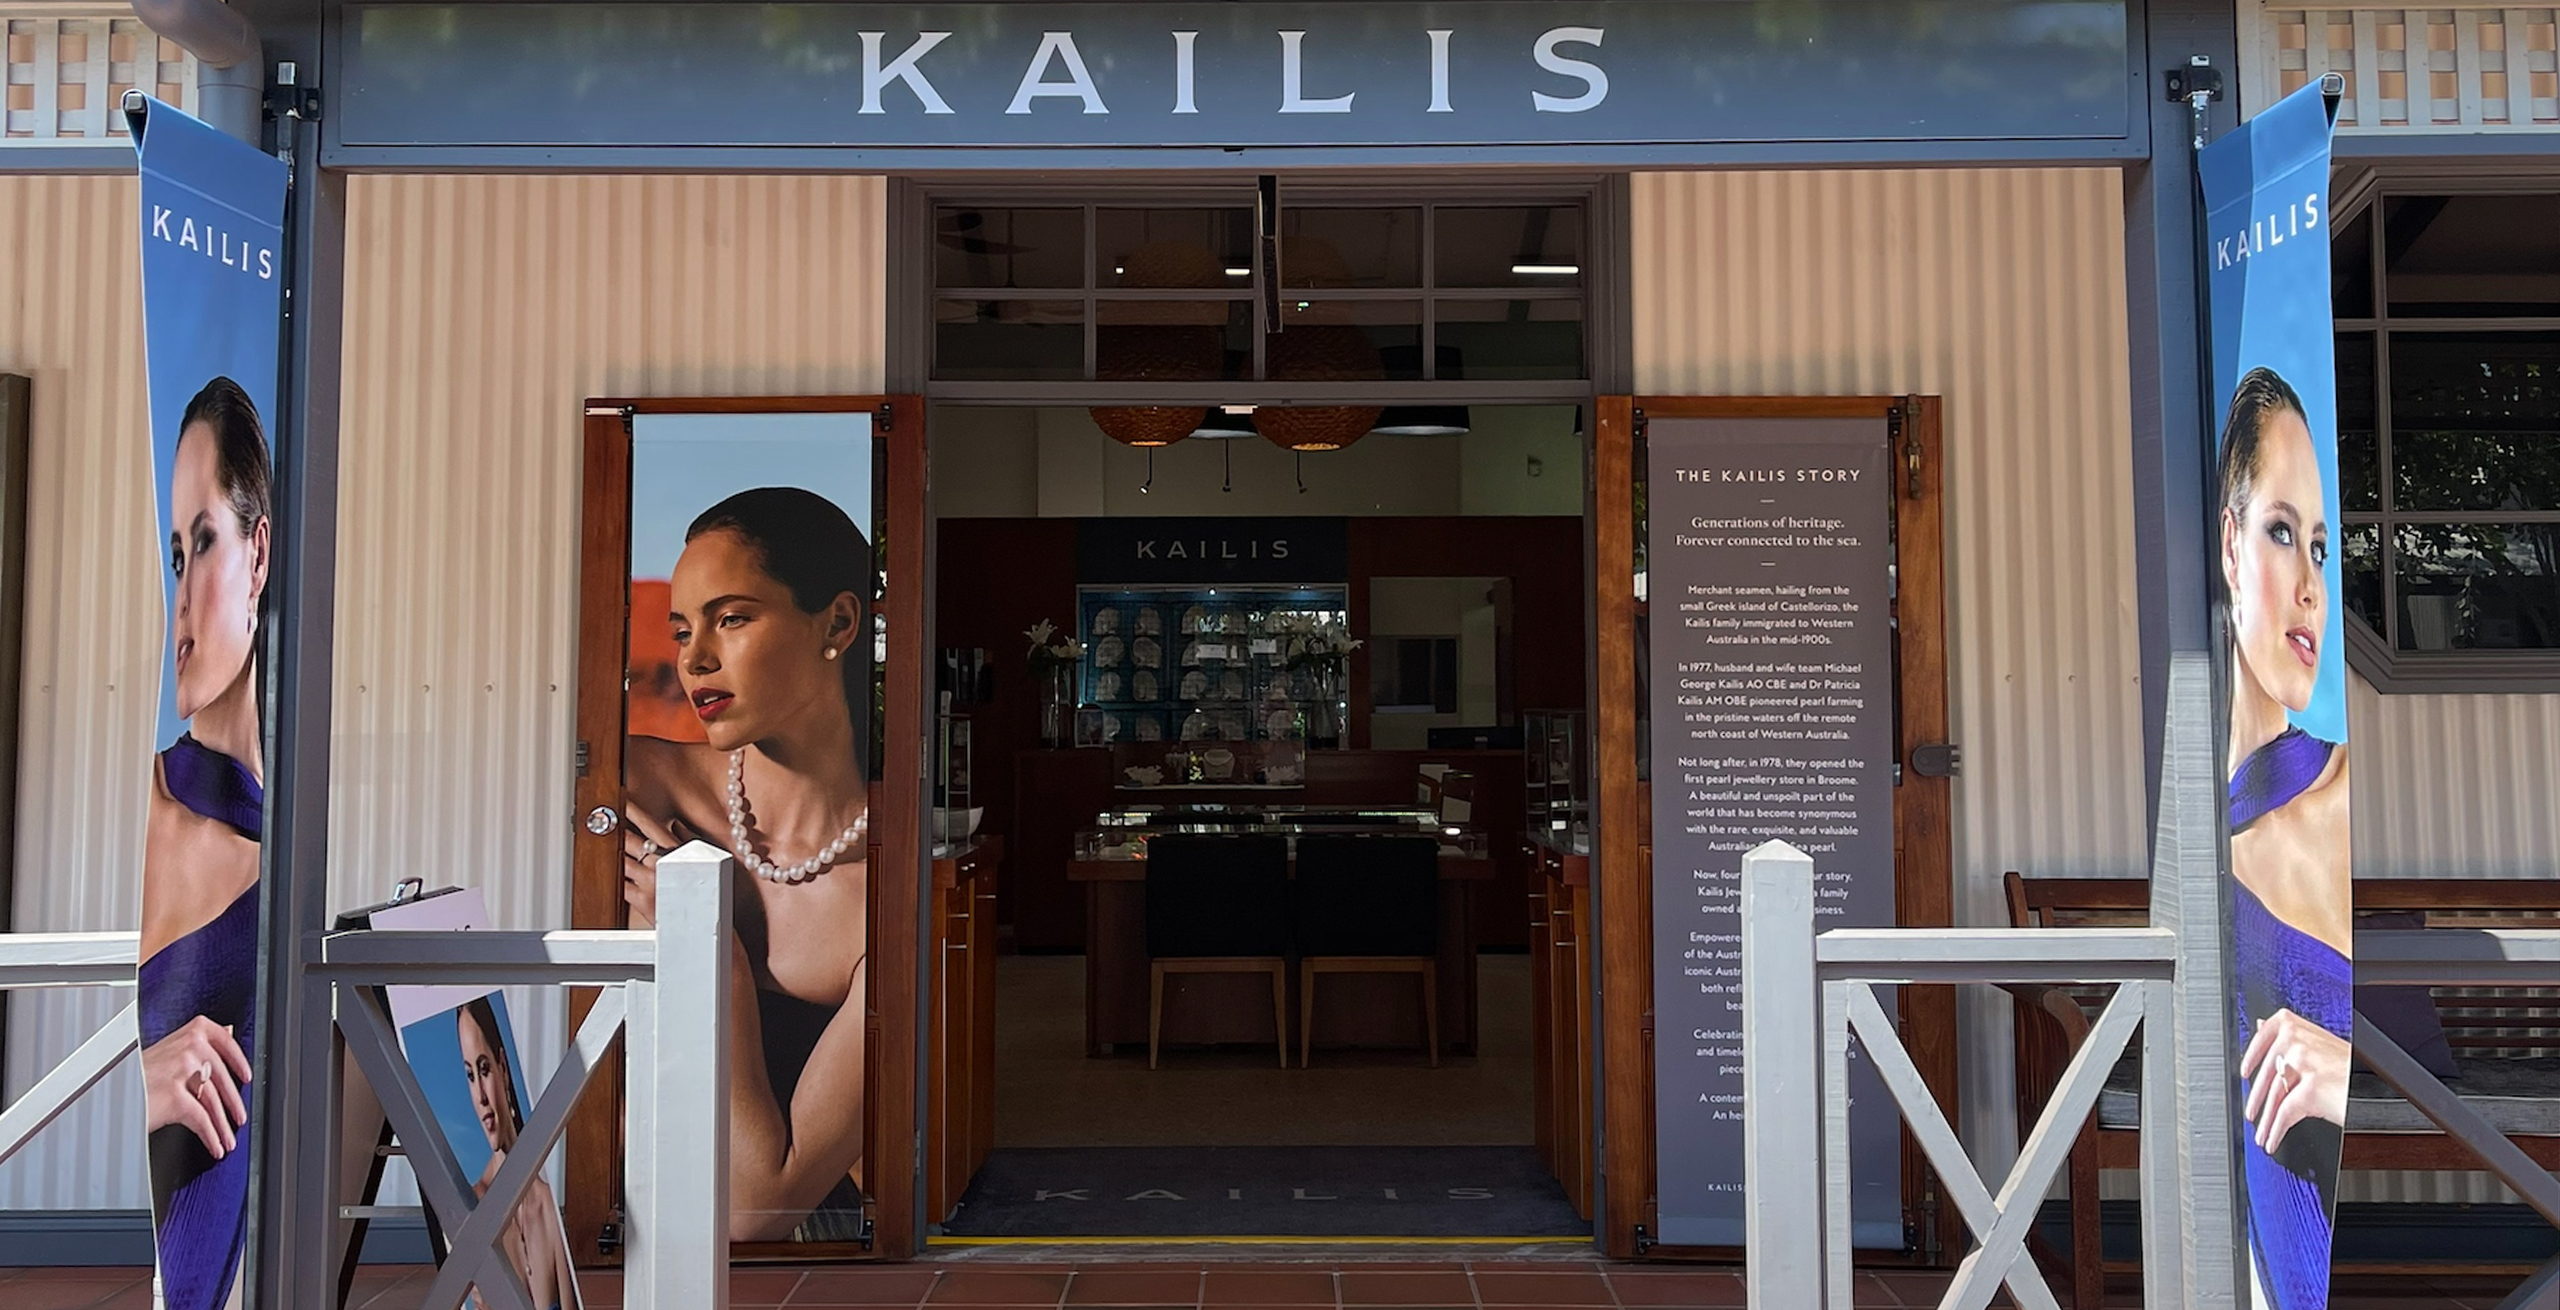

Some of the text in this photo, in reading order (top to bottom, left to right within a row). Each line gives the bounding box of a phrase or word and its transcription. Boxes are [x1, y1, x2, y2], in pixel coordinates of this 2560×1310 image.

[857, 26, 1610, 114] KAILIS
[2217, 192, 2318, 271] KAILIS
[152, 204, 272, 280] KAILIS
[1676, 470, 1859, 481] THE KAILIS STORY
[1692, 517, 1844, 531] Generations of heritage.
[1677, 535, 1861, 546] Forever connected to the sea.
[1136, 540, 1289, 559] KAILIS
[1688, 585, 1732, 594] Merchant
[1776, 585, 1806, 597] hailing
[1808, 585, 1831, 595] from
[1834, 586, 1849, 595] the
[1680, 601, 1859, 612] small Greek island of Castellorizo, the
[1686, 618, 1710, 627] Kailis
[1713, 618, 1740, 629] family
[1743, 618, 1796, 630] immigrated
[1811, 618, 1853, 628] Western
[1706, 634, 1832, 644] Australia in the mid-1900s.
[1679, 663, 1688, 671] In
[1690, 662, 1712, 672] 1977,
[1714, 663, 1753, 672] husband
[1756, 663, 1773, 672] and
[1775, 663, 1795, 672] wife
[1825, 663, 1861, 673] Michael
[1680, 679, 1860, 691] George Kailis AO CBE and Dr Patricia
[1678, 695, 1863, 708] Kailis AM OBE pioneered pearl farming
[1685, 712, 1856, 724] in the pristine waters off the remote
[1691, 729, 1849, 739] north coast of Western Australia.
[1679, 757, 1864, 770] Not long after, in 1978, they opened the
[1685, 773, 1858, 786] first pearl jewellery store in Broome.
[1689, 791, 1854, 803] A beautiful and unspoilt part of the
[1687, 808, 1857, 820] world that has become synonymous
[1686, 824, 1707, 833] with
[1709, 824, 1725, 834] the
[1752, 826, 1797, 836] exquisite,
[1799, 825, 1817, 834] and
[1819, 826, 1858, 835] valuable
[1810, 843, 1837, 854] pearl.
[1693, 869, 1719, 880] Now,
[1721, 869, 1740, 879] four
[1698, 886, 1723, 896] Kailis
[1820, 887, 1849, 900] family
[1702, 904, 1734, 913] owned
[1814, 905, 1845, 914] siness.
[1690, 931, 1741, 944] Empowere
[1684, 949, 1742, 959] of the Austr
[1684, 966, 1742, 976] iconic Austr
[1701, 983, 1724, 993] both
[1693, 1029, 1743, 1039] Celebratin
[1696, 1046, 1714, 1056] and
[1699, 1094, 1708, 1103] A
[1712, 1111, 1727, 1120] An
[1034, 1188, 1495, 1200] KAILIS
